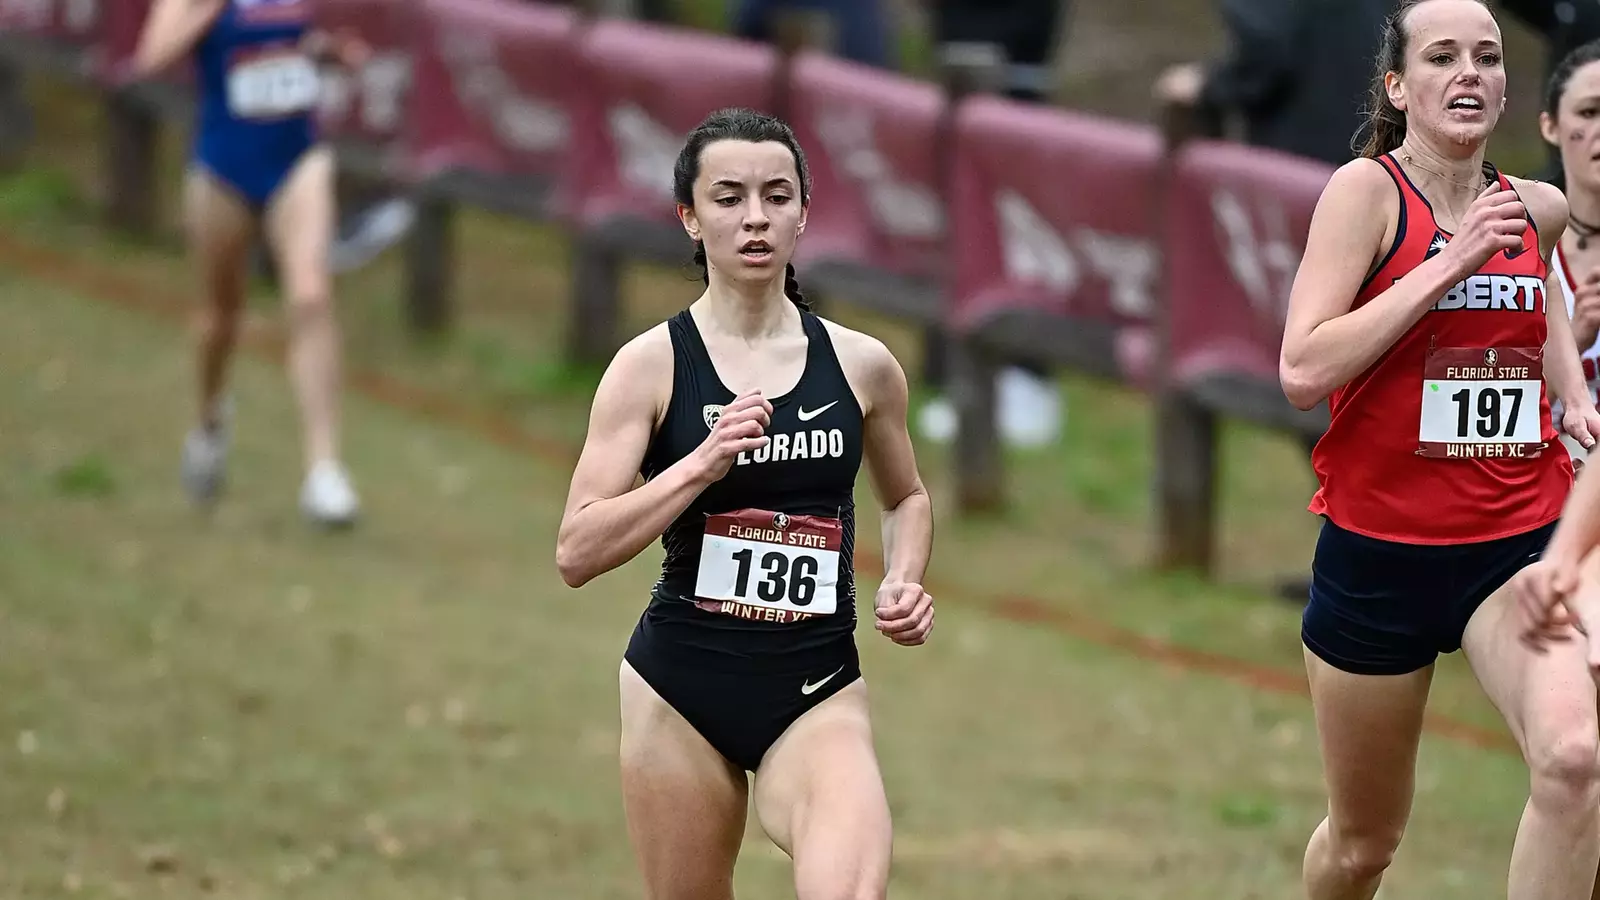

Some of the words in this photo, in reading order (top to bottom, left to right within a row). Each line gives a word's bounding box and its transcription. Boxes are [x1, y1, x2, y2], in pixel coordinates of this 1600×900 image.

[1394, 275, 1546, 314] BERTY
[1447, 367, 1494, 379] FLORIDA
[1498, 367, 1529, 379] STATE
[1452, 388, 1523, 438] 197
[736, 428, 844, 465] LORADO
[1446, 443, 1504, 457] WINTER
[1508, 443, 1525, 457] XC
[728, 524, 783, 544] FLORIDA
[788, 533, 827, 548] STATE
[732, 548, 818, 607] 136
[721, 601, 786, 623] WINTER
